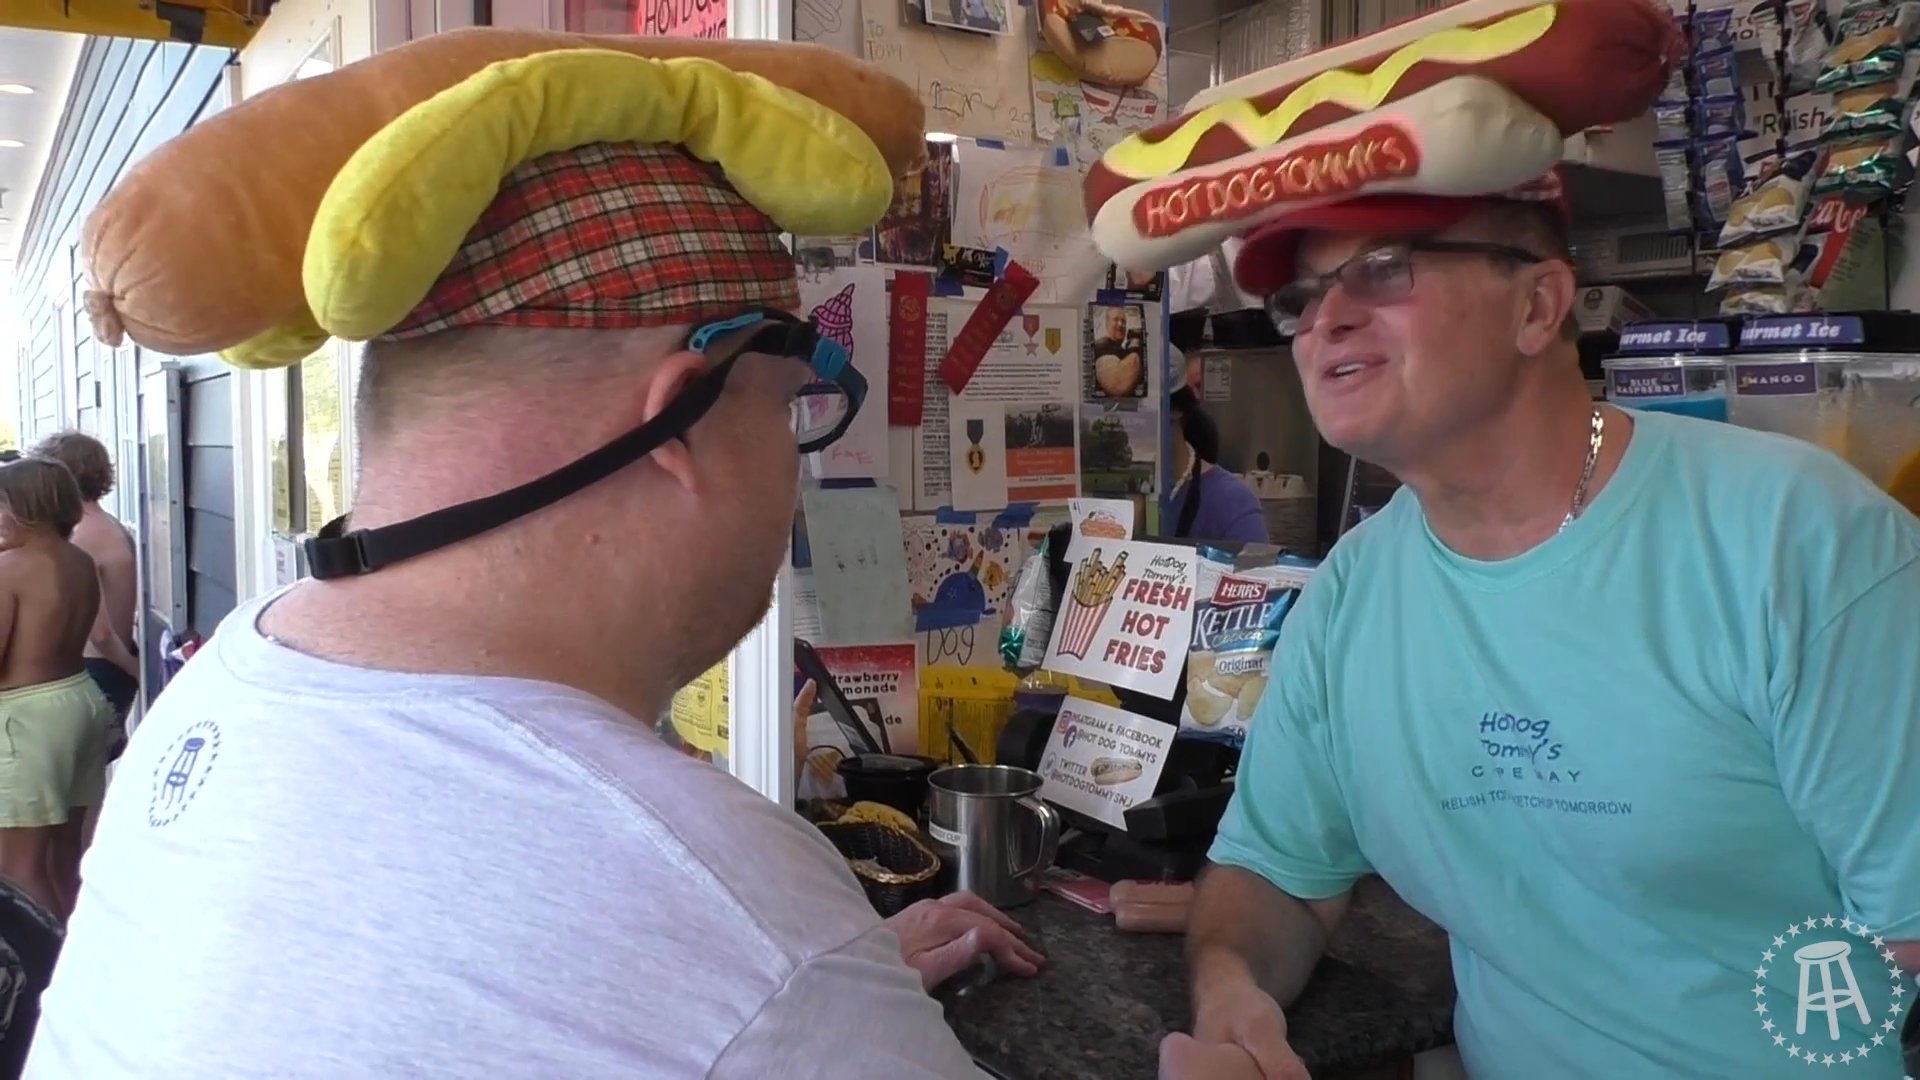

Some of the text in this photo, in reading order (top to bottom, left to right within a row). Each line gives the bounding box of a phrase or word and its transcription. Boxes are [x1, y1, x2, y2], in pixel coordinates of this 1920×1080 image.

[1145, 183, 1201, 234] HOT
[1206, 167, 1276, 216] DOG
[1675, 328, 1708, 343] Ice
[1806, 322, 1841, 338] Ice
[1630, 378, 1658, 387] BLUE
[1745, 374, 1806, 385] MANGO
[1121, 578, 1192, 612] FRESH
[1119, 609, 1171, 640] HOT
[1102, 638, 1167, 674] FRIES
[831, 671, 900, 684] trawberry
[841, 682, 897, 695] monade
[1115, 725, 1164, 749] FACEBOOK
[1098, 736, 1117, 750] DOG
[1120, 742, 1158, 764] TOMMYS
[1060, 758, 1089, 777] TWITTER
